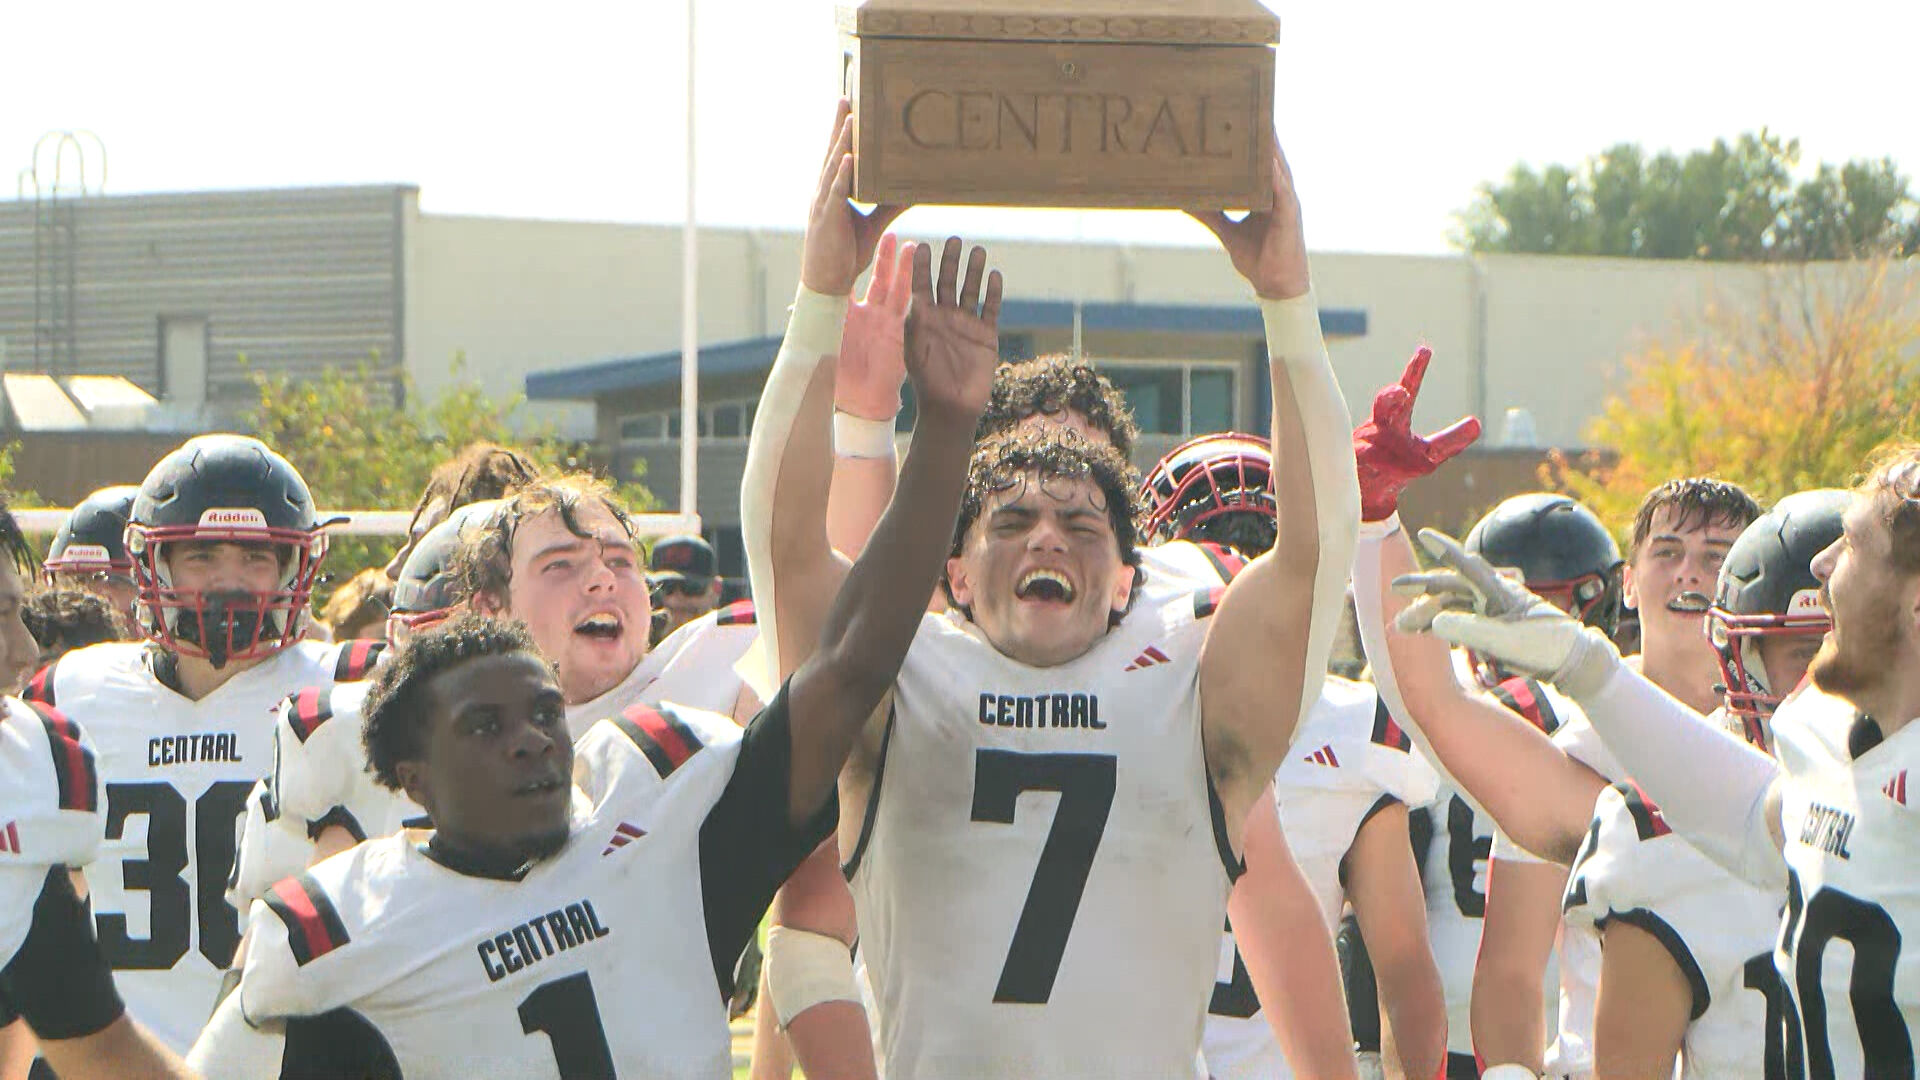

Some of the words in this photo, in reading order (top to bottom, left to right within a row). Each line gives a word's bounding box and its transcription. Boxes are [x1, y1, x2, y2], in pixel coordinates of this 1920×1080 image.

[149, 733, 242, 766] CENTRAL
[979, 693, 1107, 729] CENTRAL
[971, 748, 1118, 1004] 7
[477, 899, 610, 982] CENTRAL
[517, 970, 618, 1080] 1
